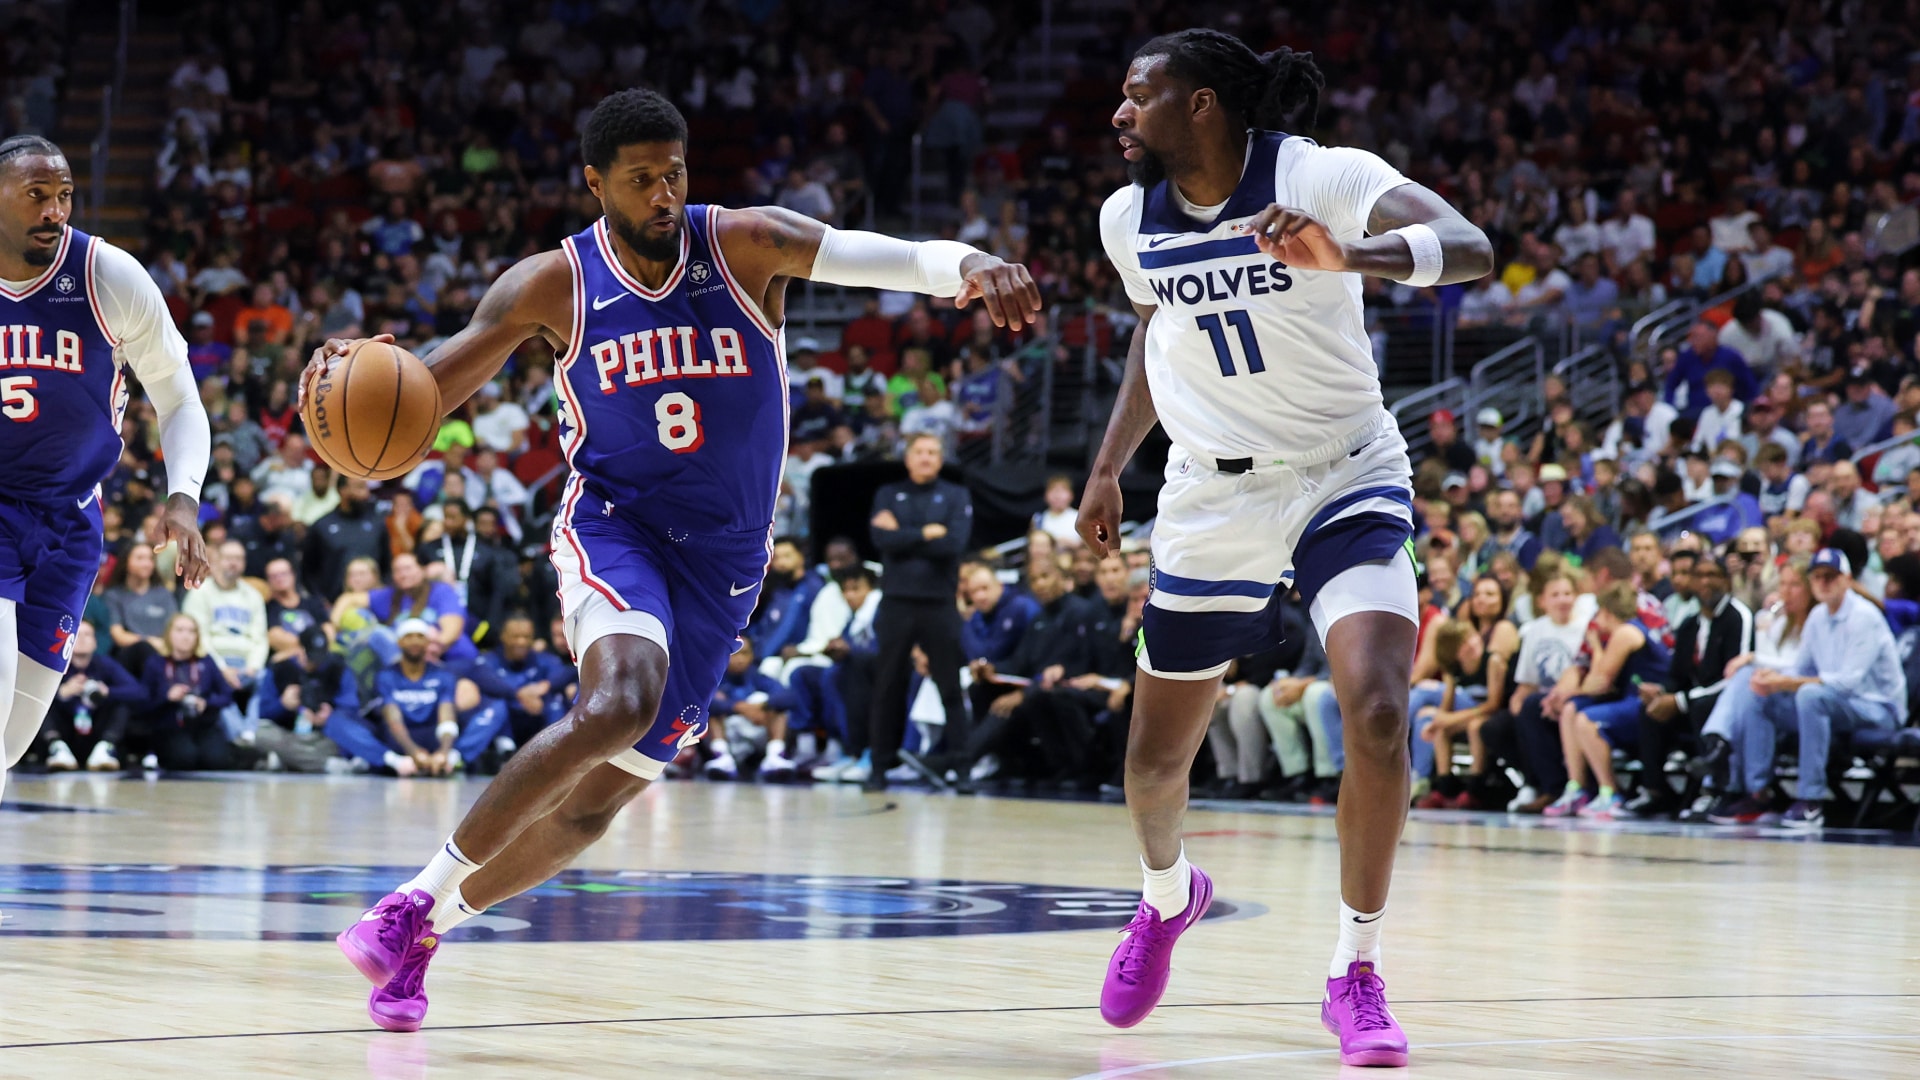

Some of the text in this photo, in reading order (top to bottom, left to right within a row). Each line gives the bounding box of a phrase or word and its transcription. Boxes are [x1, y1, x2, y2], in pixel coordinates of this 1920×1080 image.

[1149, 261, 1293, 307] WOLVES
[0, 324, 85, 374] ILA
[590, 326, 753, 396] PHILA
[1195, 309, 1266, 378] 11
[0, 376, 39, 423] 5
[654, 391, 705, 455] 8
